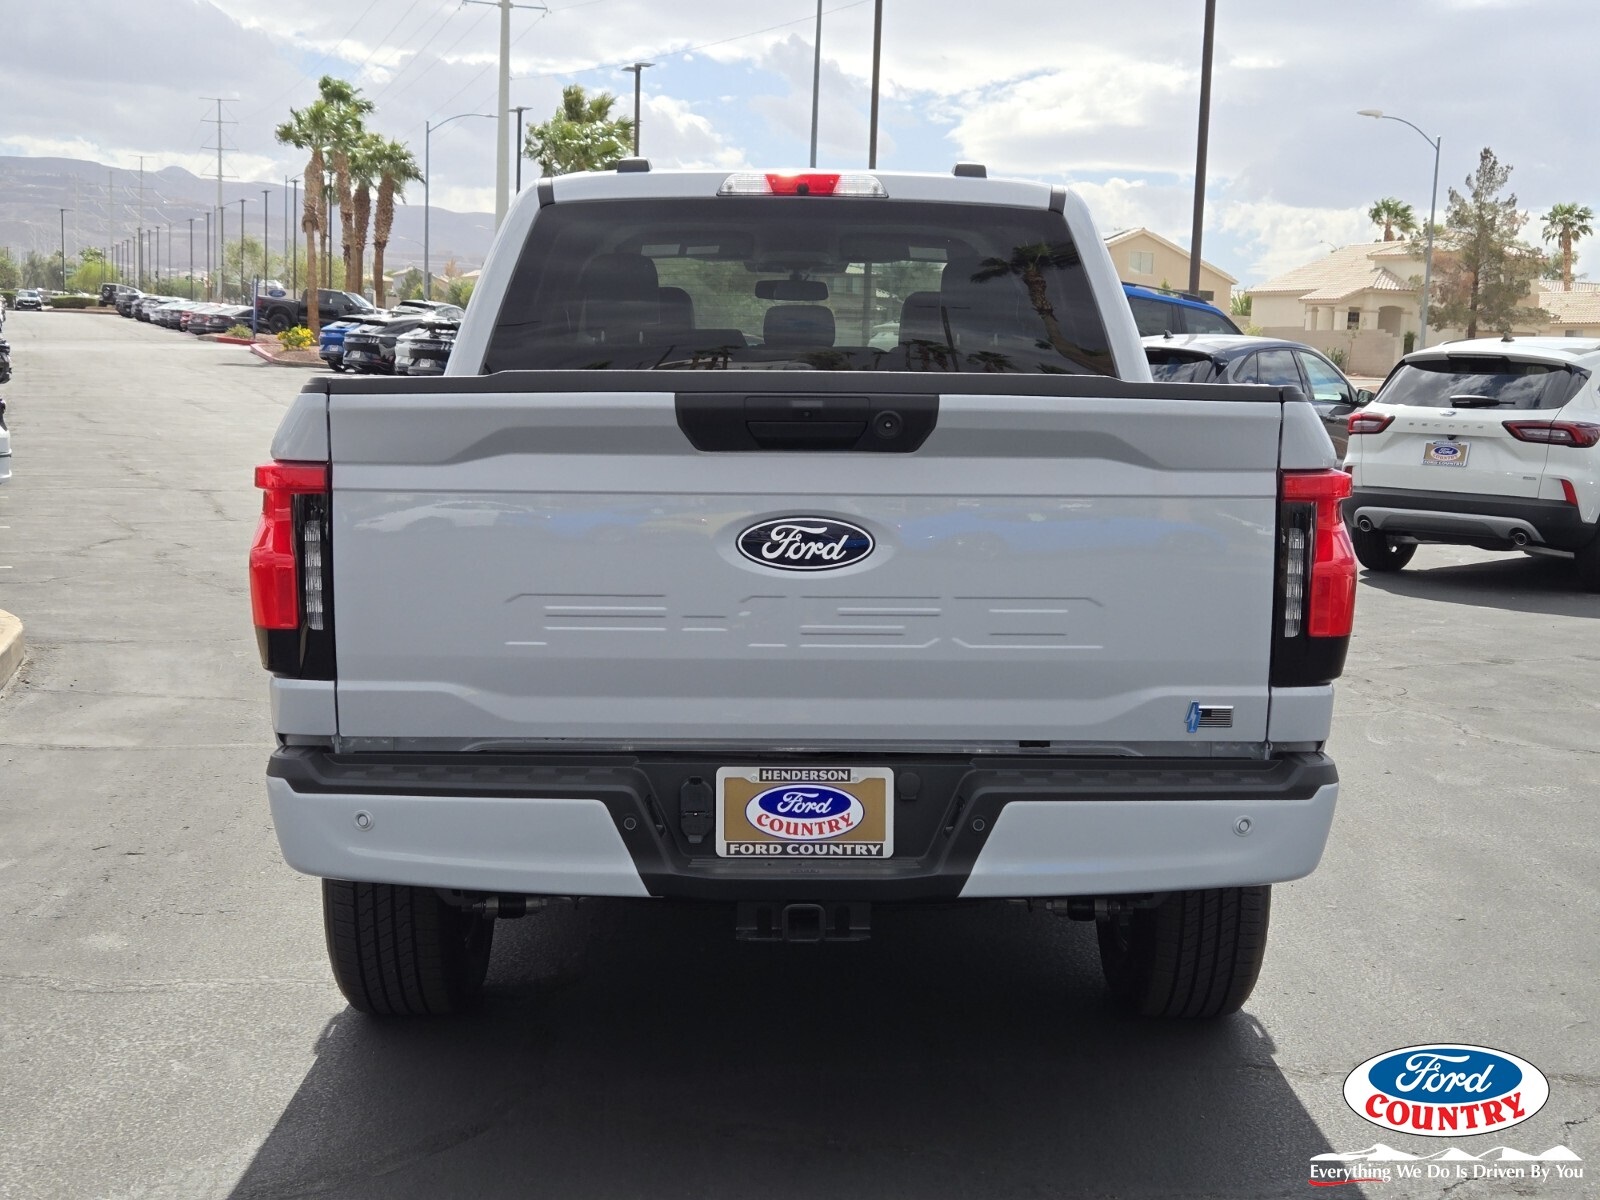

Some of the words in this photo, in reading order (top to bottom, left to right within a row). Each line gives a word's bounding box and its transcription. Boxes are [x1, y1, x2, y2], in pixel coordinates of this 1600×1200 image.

[1438, 447, 1454, 455] Ford
[761, 524, 850, 560] Ford
[761, 770, 849, 781] HENDERSON
[776, 791, 834, 814] Ford
[756, 813, 854, 836] COUNTRY
[729, 843, 783, 856] FORD
[786, 844, 882, 856] COUNTRY
